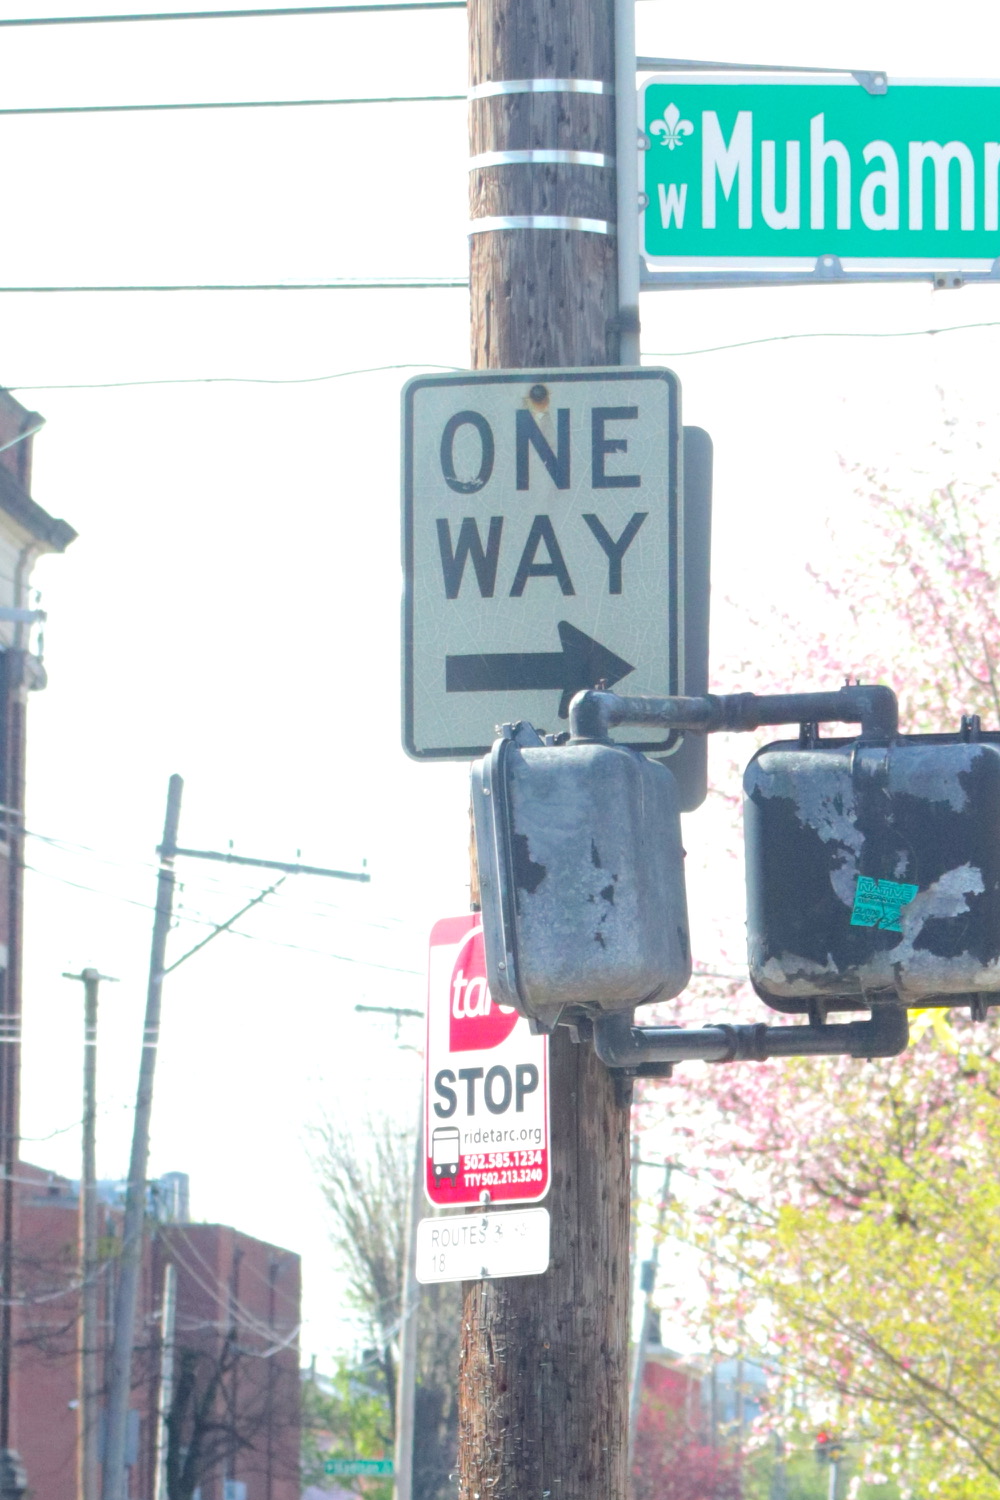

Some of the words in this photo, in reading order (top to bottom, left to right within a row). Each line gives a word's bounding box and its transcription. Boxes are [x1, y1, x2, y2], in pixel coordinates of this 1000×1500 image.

[658, 183, 687, 229] W
[440, 406, 641, 494] ONE
[436, 512, 650, 600] WAY
[452, 969, 516, 1019] tar
[433, 1063, 539, 1119] STOP
[464, 1128, 542, 1144] ridetarc.org
[463, 1150, 543, 1171] 502.585.1234
[463, 1173, 481, 1187] TTY
[431, 1225, 487, 1247] ROUTES
[431, 1253, 446, 1273] 18
